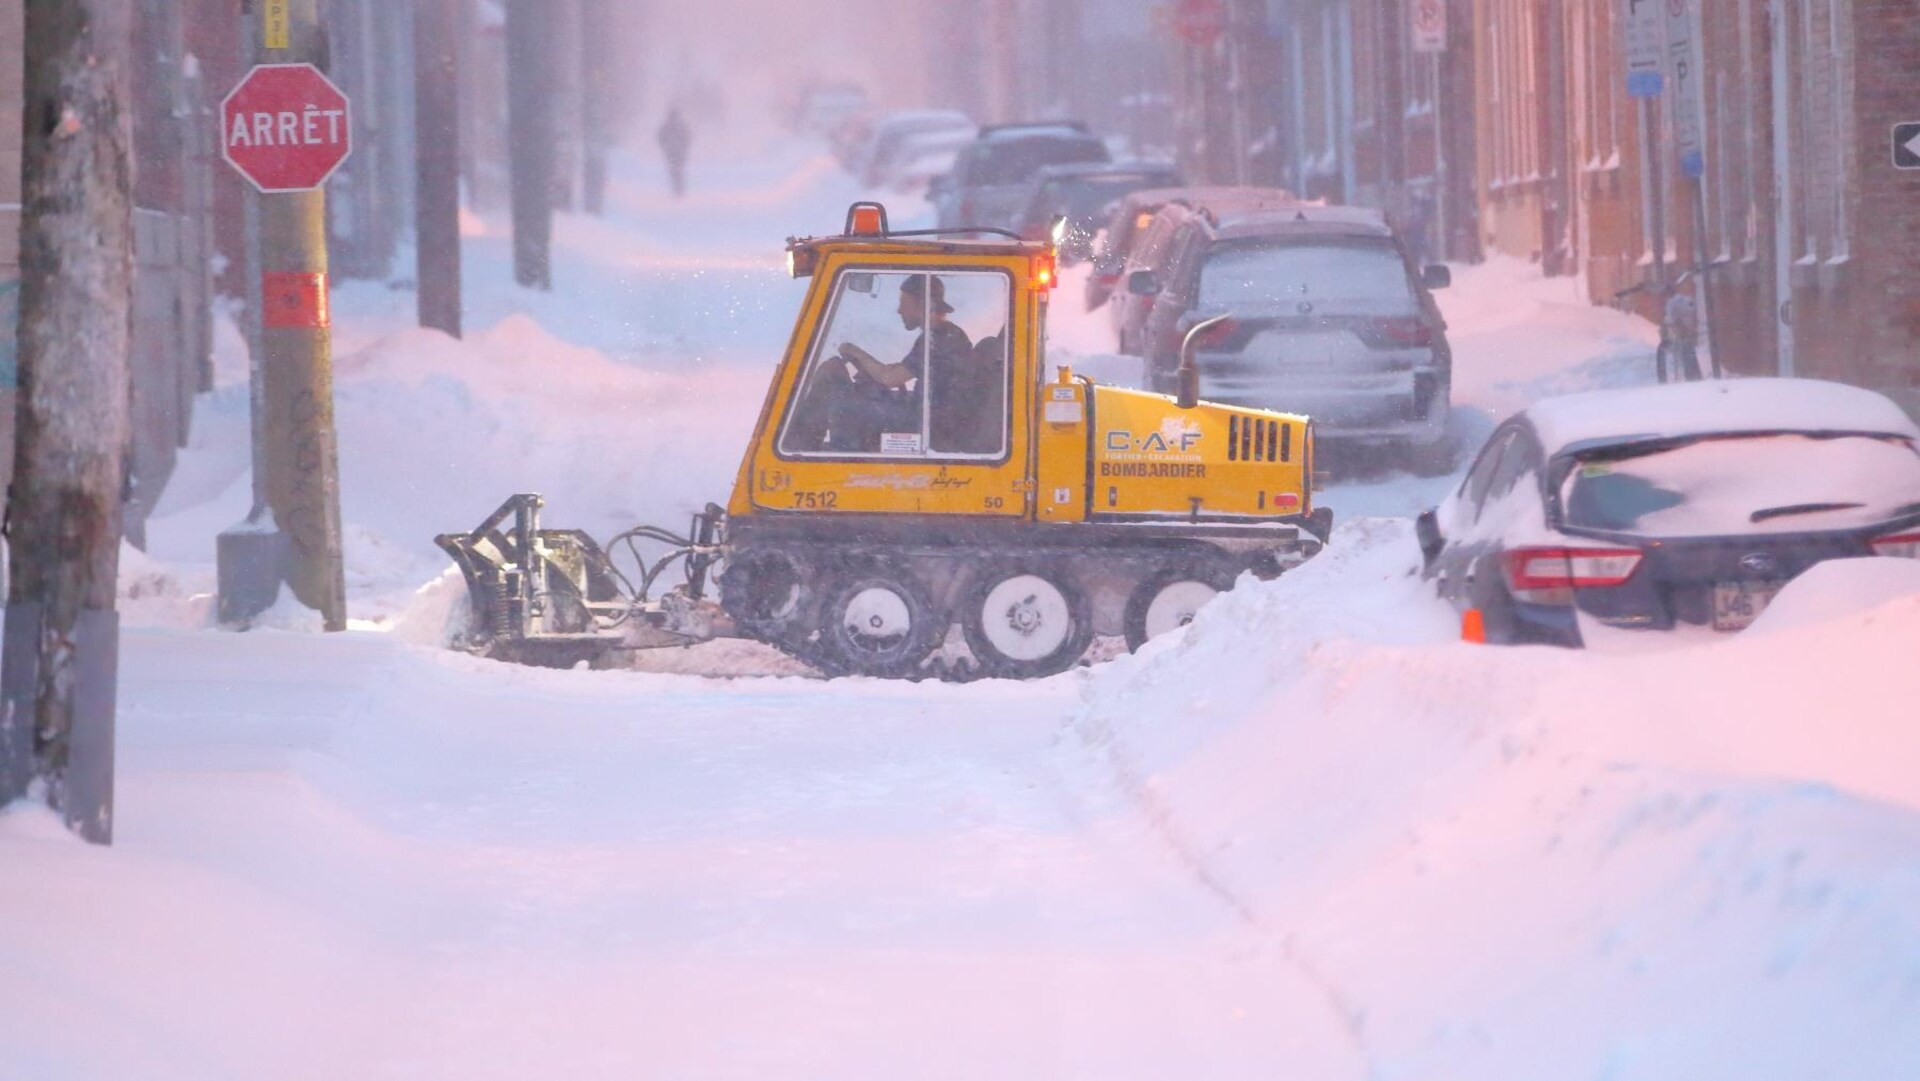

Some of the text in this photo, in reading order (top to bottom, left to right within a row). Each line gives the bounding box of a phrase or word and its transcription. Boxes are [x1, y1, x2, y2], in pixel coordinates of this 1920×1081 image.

[229, 104, 344, 147] ARRÊT
[1148, 453, 1202, 462] EXCAVATION
[1101, 462, 1206, 478] BOMBARDIER
[793, 491, 837, 509] 7512
[984, 496, 1003, 508] 50
